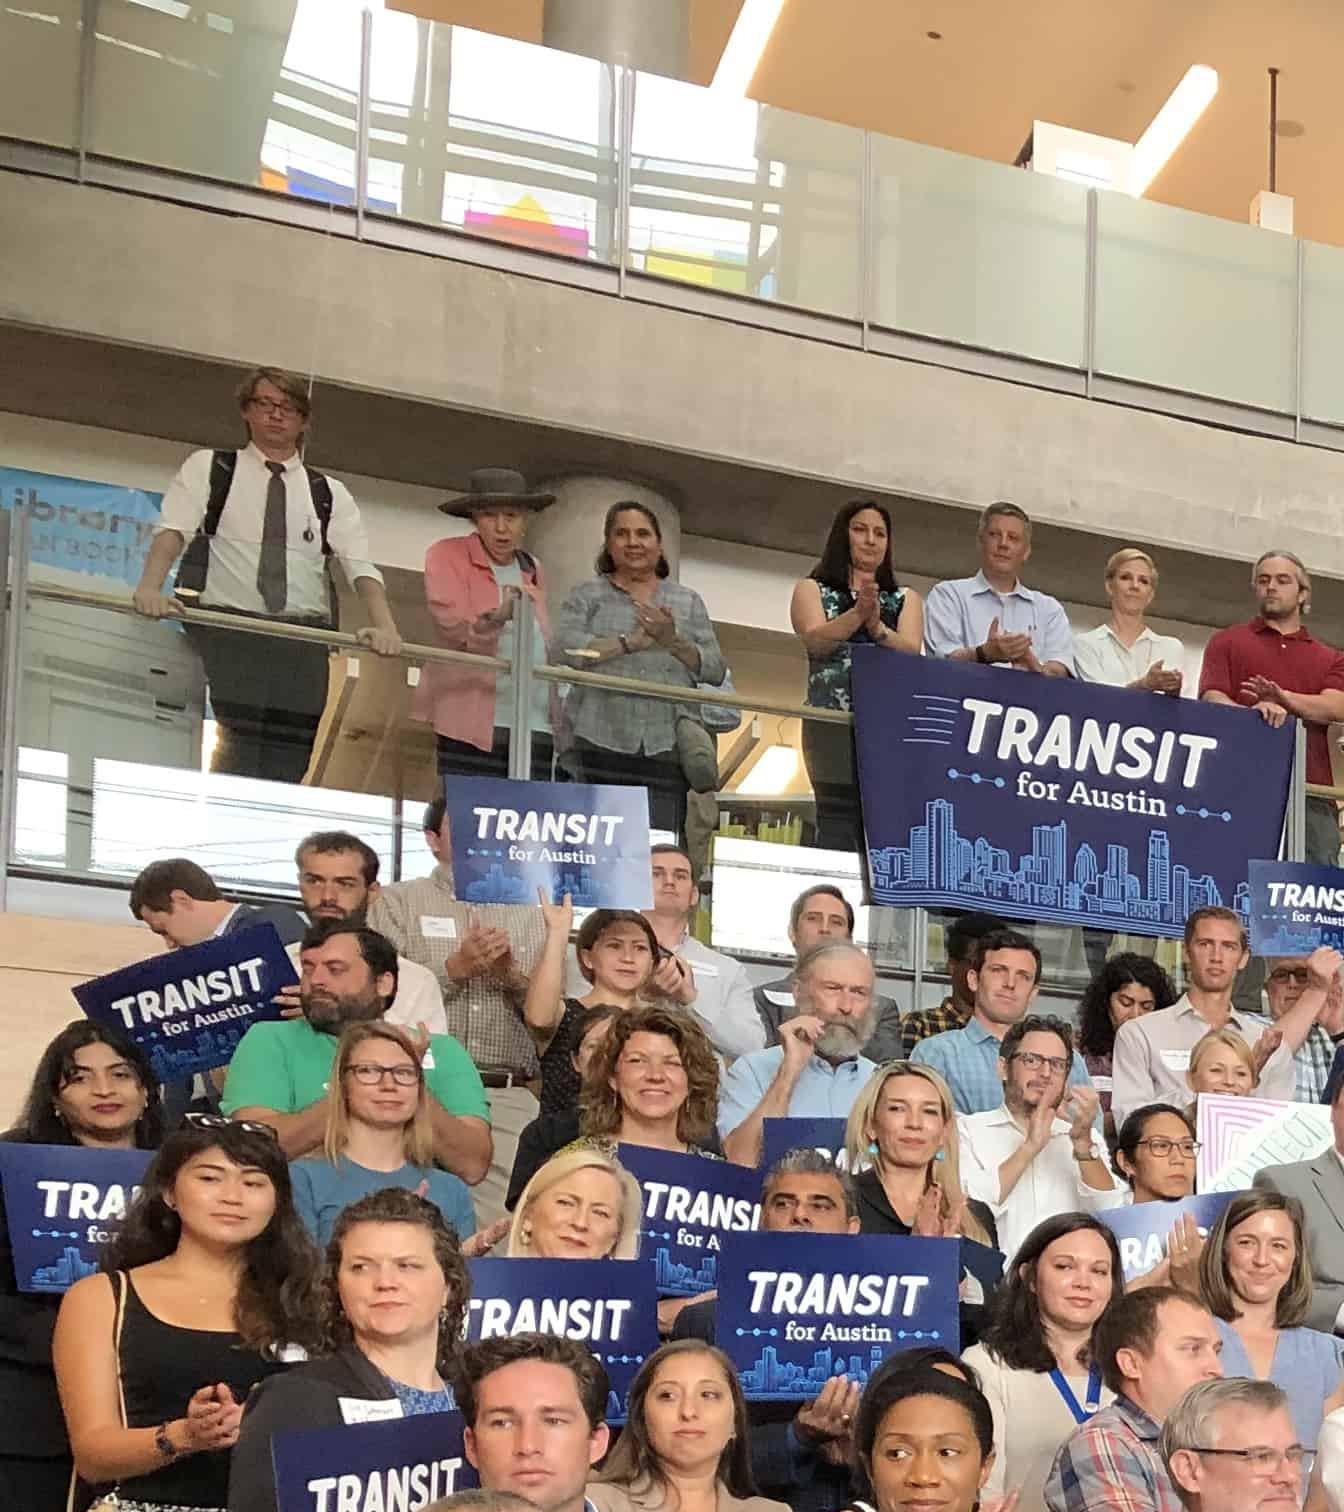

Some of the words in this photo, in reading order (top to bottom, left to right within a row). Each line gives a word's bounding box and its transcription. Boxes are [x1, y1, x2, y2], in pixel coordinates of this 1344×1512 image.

[0, 488, 153, 547] ibrary
[963, 698, 1217, 788] TRANSIT
[1016, 771, 1060, 800] for
[1067, 780, 1167, 817] Austin
[473, 807, 623, 846] TRANSIT
[508, 845, 533, 862] for
[539, 849, 596, 865] Austin
[1292, 910, 1311, 922] for
[112, 957, 264, 1029] TRANSIT
[162, 1019, 190, 1037] for
[195, 1003, 255, 1028] Austin
[643, 1182, 761, 1232] TRANSI
[676, 1229, 703, 1249] for
[748, 1271, 928, 1316] TRANSIT
[785, 1320, 814, 1341] for
[820, 1323, 892, 1342] Austin
